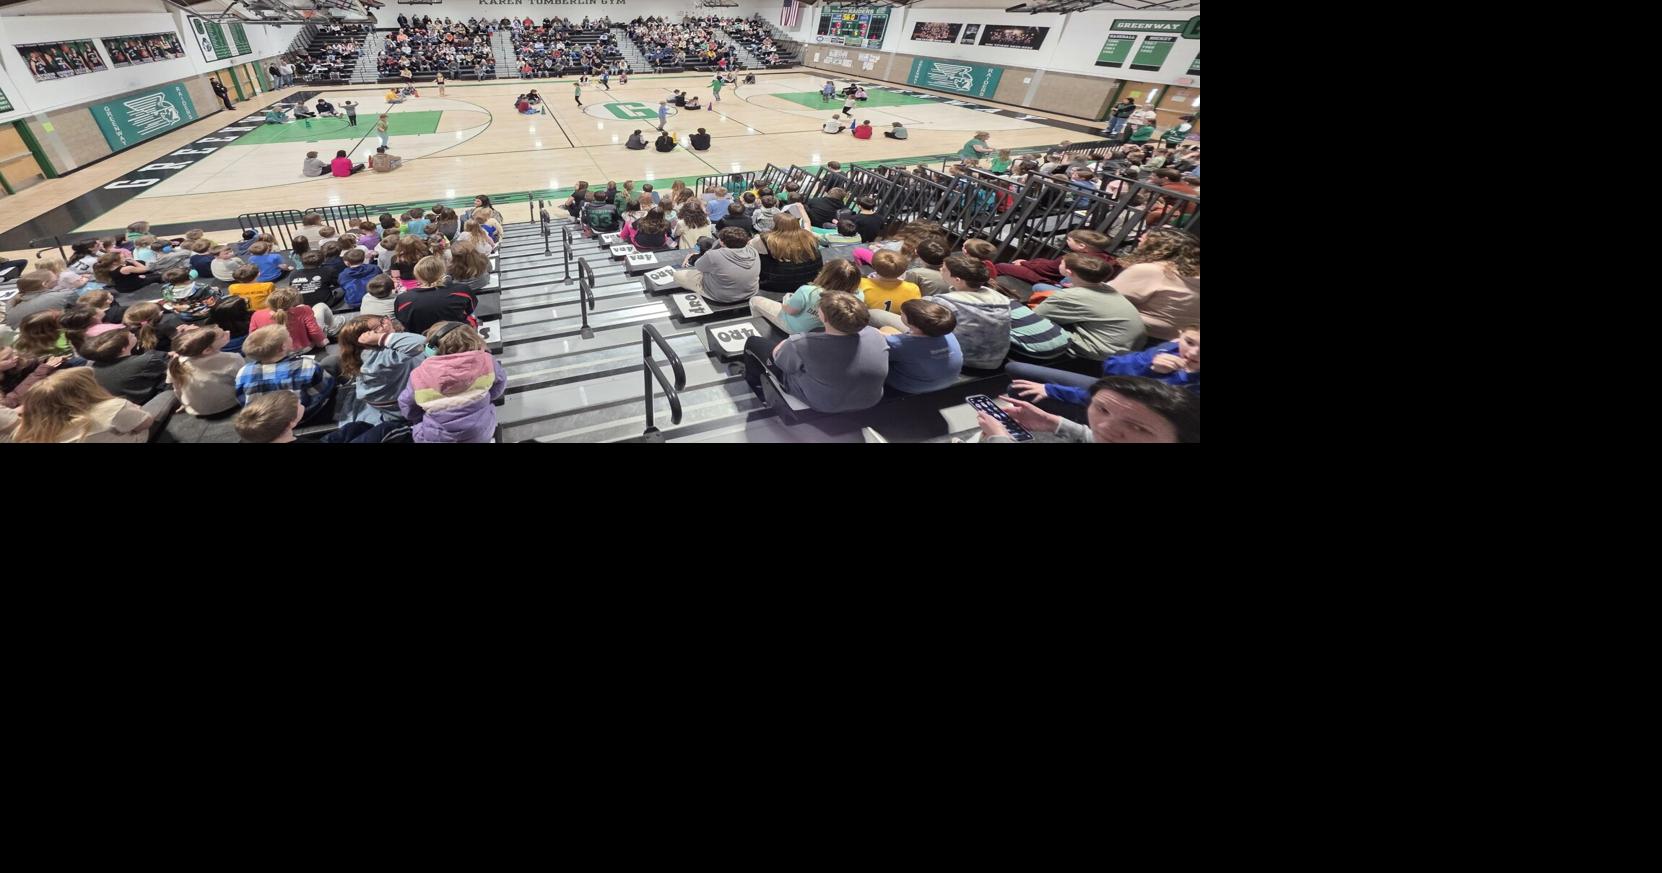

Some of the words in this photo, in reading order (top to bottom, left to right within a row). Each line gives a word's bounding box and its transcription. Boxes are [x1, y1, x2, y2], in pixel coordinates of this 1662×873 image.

[1117, 22, 1180, 30] GREENWAY
[684, 294, 705, 314] 4RO
[717, 327, 756, 342] 4RO
